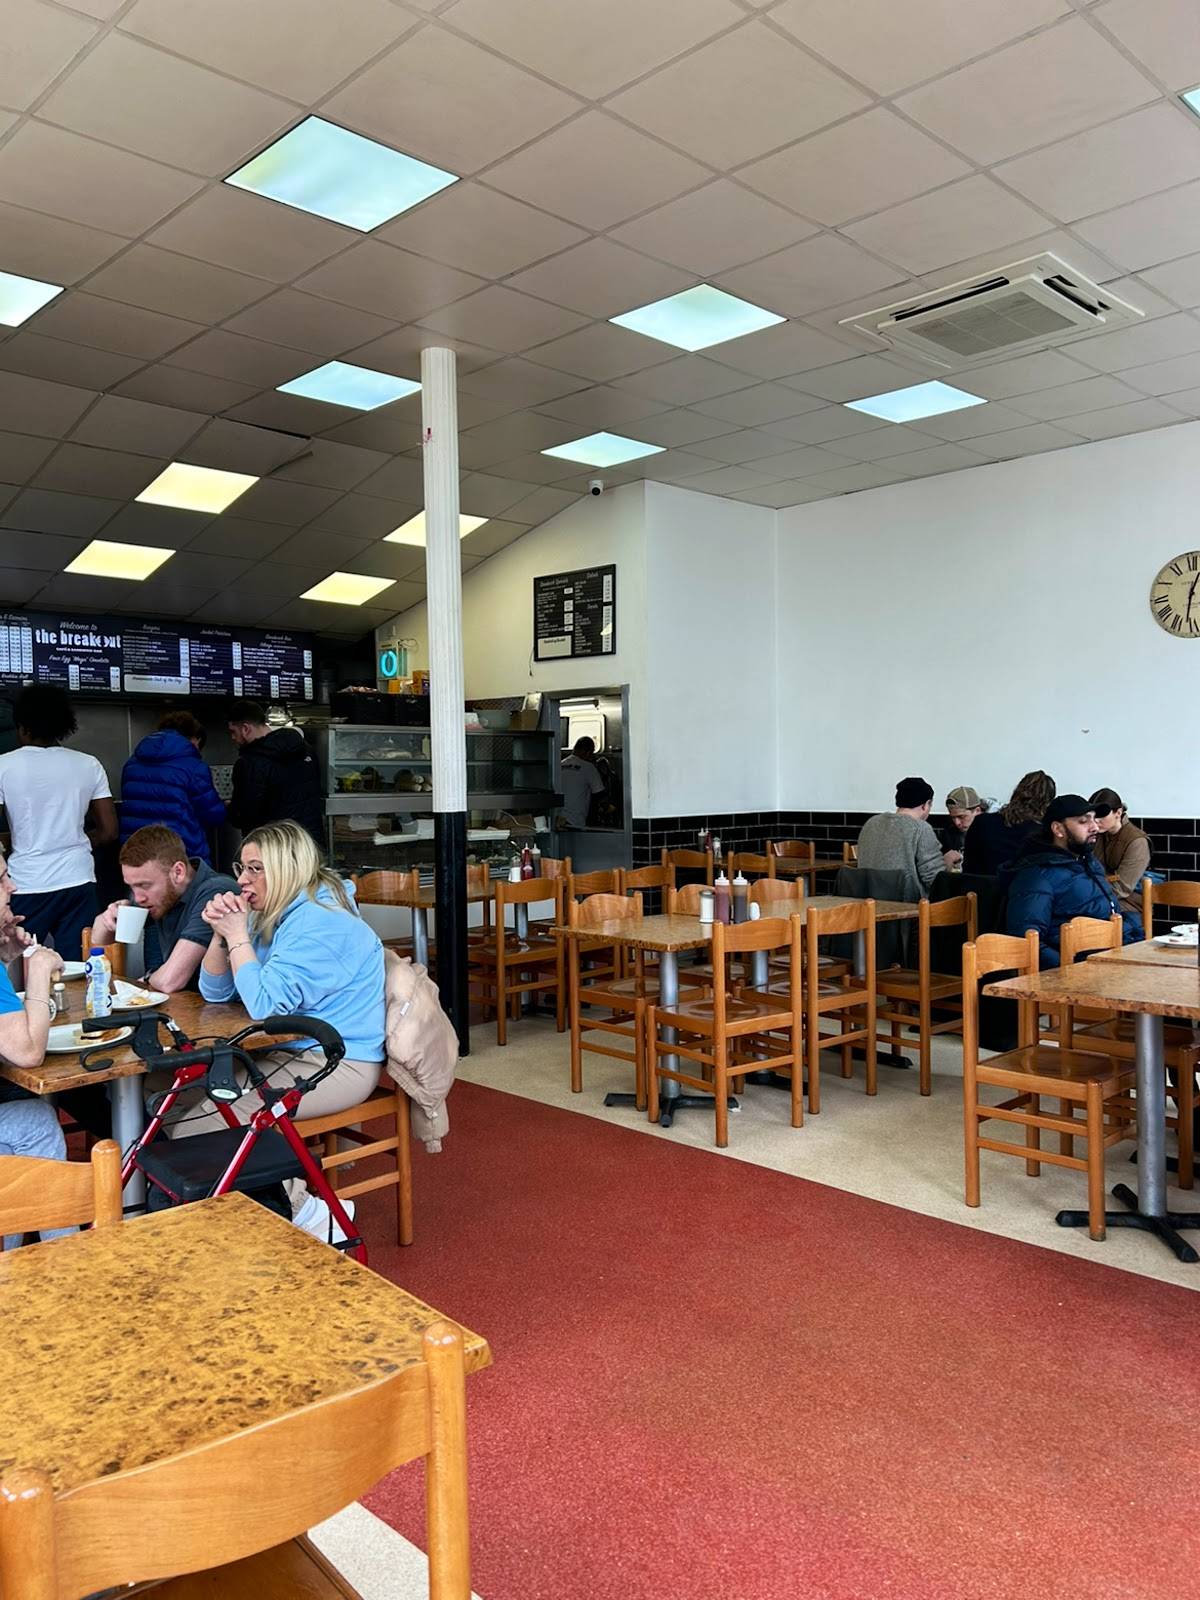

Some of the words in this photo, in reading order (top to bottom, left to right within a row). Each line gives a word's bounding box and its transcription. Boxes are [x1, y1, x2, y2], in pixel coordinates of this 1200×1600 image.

[60, 621, 89, 631] Welcome
[90, 623, 98, 631] to
[35, 628, 57, 645] the
